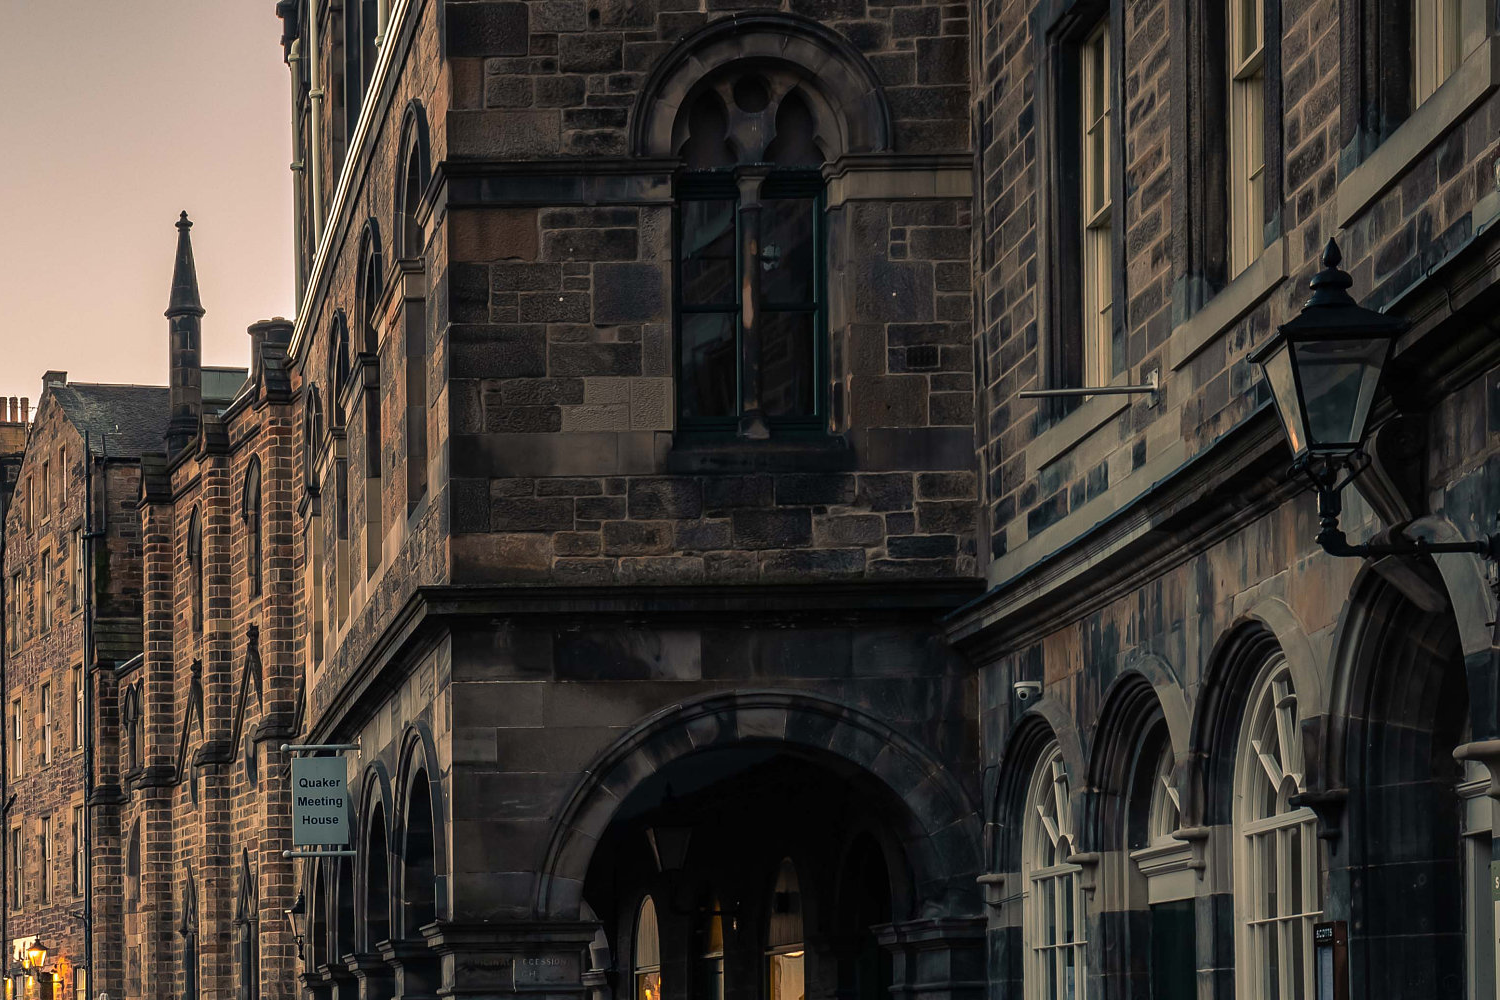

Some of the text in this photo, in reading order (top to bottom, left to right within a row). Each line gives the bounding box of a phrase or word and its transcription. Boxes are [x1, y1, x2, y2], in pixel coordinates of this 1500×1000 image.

[298, 777, 341, 788] Quaker
[297, 796, 343, 808] Meeting
[302, 815, 339, 825] House
